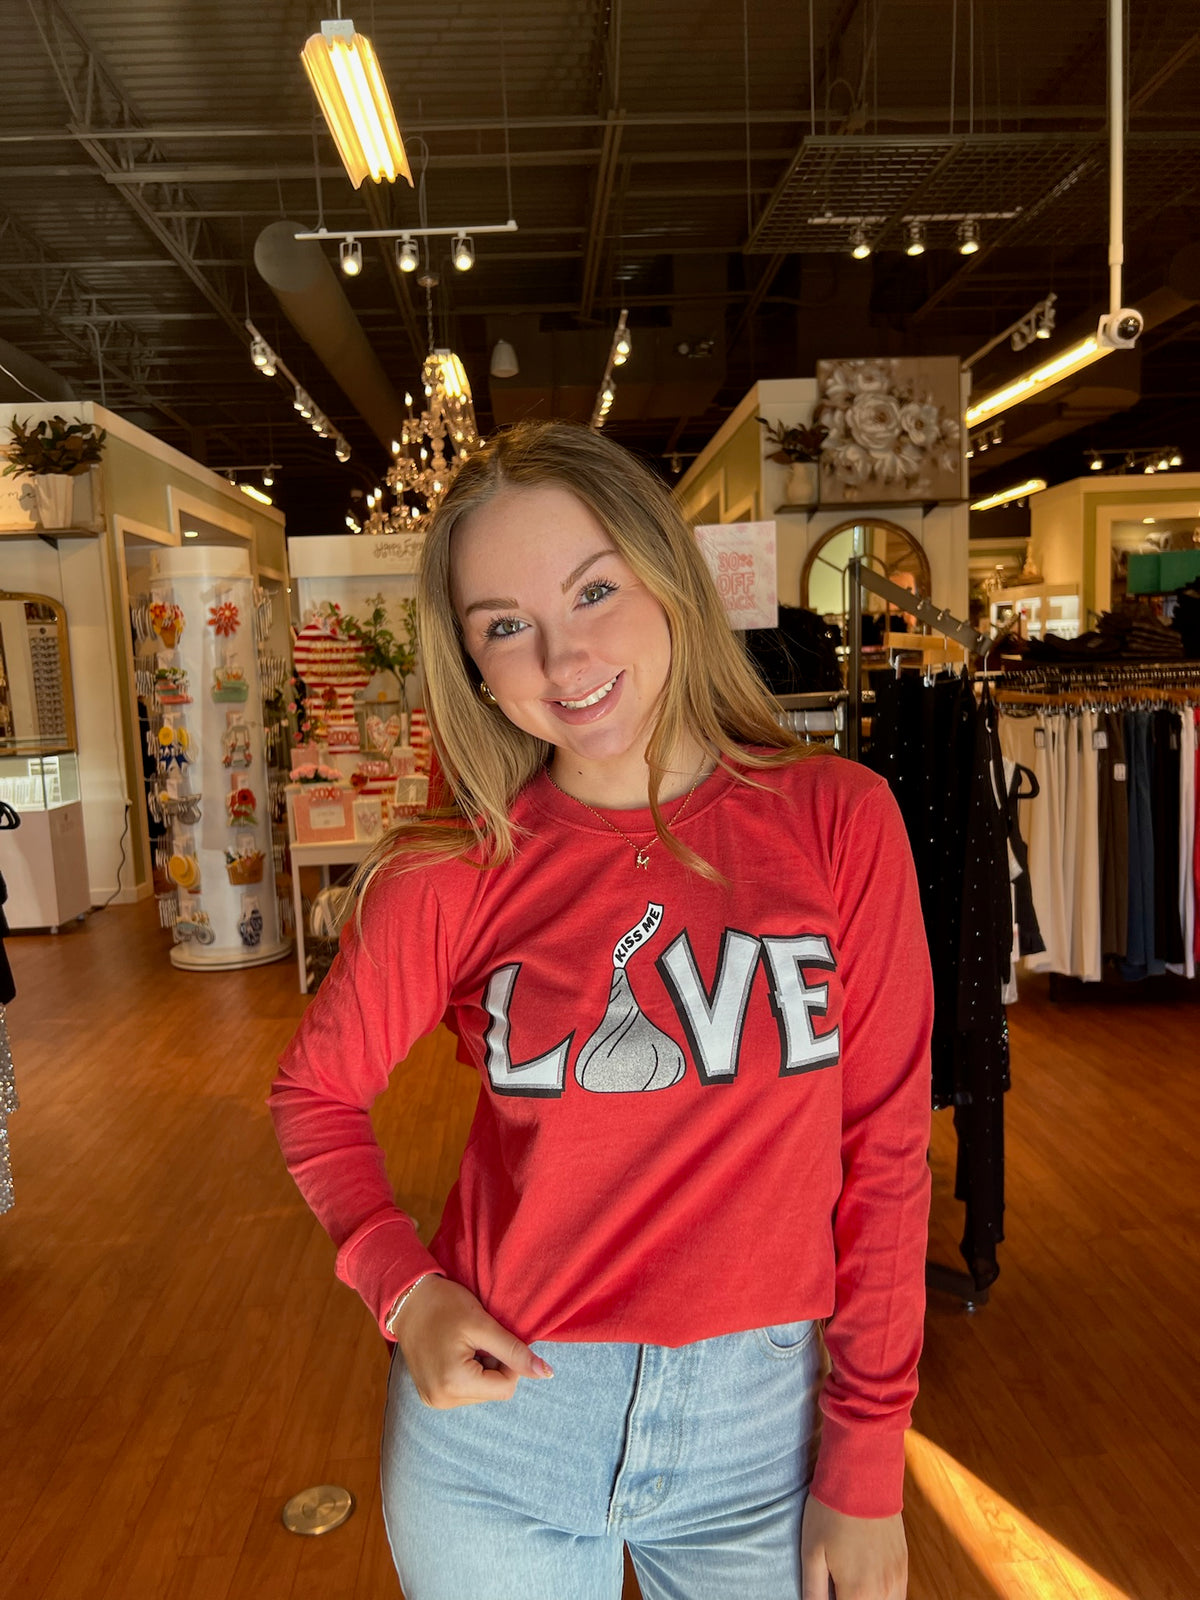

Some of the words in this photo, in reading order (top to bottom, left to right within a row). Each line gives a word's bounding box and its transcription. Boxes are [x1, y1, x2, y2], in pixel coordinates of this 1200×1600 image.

[716, 572, 756, 597] OFF
[614, 930, 643, 963] KISS
[641, 907, 661, 933] ME
